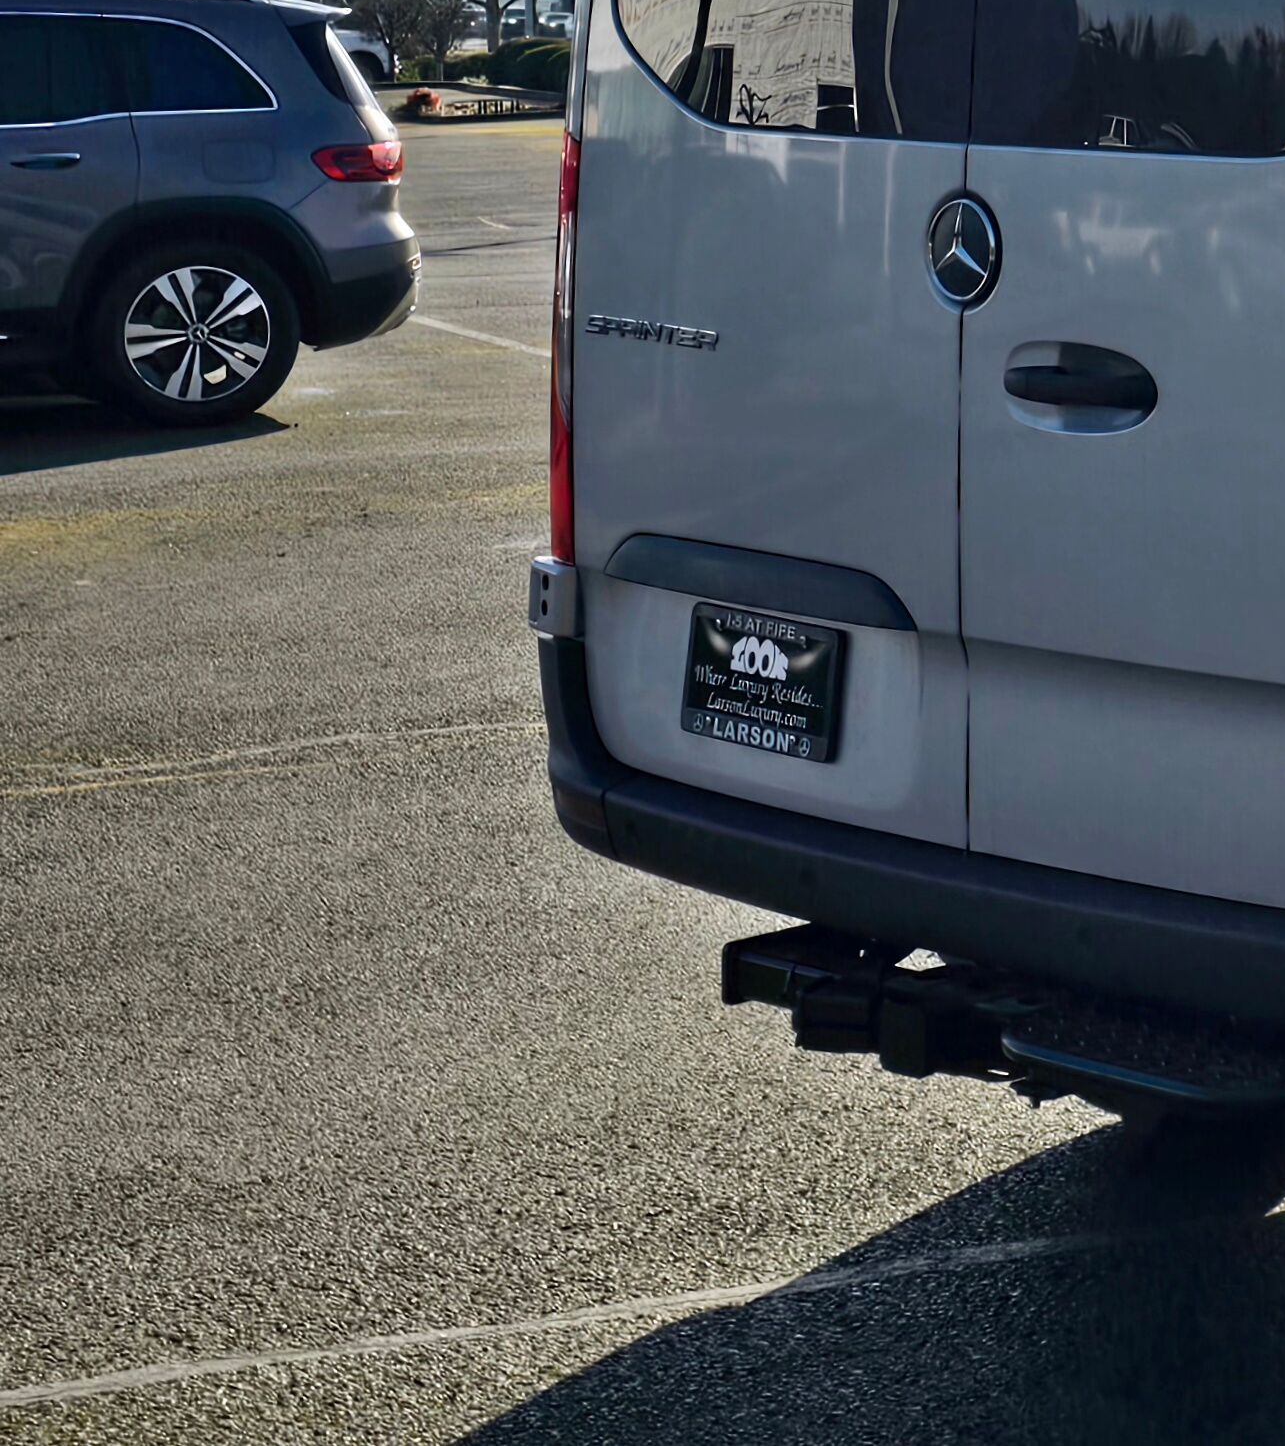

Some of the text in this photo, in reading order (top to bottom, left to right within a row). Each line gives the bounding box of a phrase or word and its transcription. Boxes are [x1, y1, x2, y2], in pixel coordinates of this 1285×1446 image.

[586, 314, 720, 351] SPRINTER
[744, 617, 763, 635] AT
[766, 621, 796, 640] FIFE
[694, 665, 728, 686] Where
[729, 673, 769, 704] Luxury
[706, 691, 807, 729] LarsonLuxury.com
